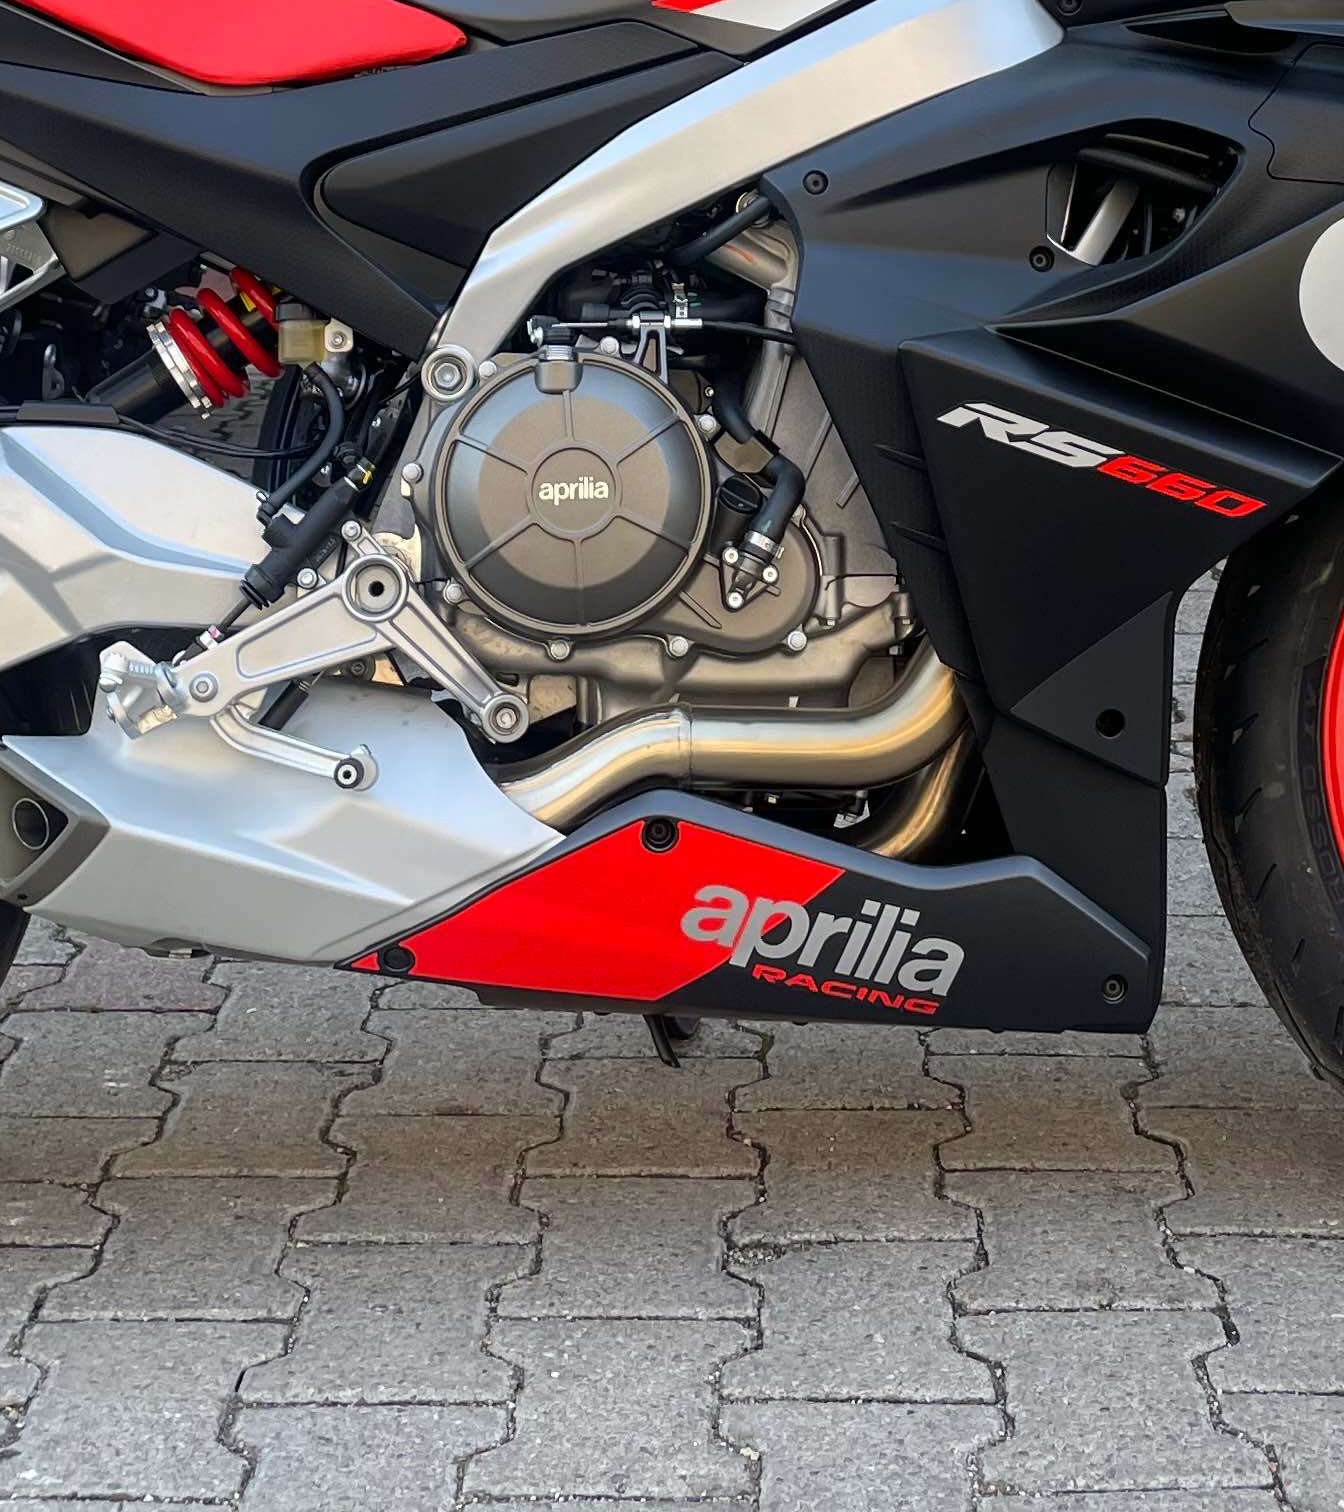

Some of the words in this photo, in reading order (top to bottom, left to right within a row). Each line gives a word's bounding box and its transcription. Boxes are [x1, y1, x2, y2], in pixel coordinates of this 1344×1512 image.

[538, 477, 610, 506] aprilia
[678, 883, 967, 997] aprilia
[751, 963, 940, 1015] RACING
